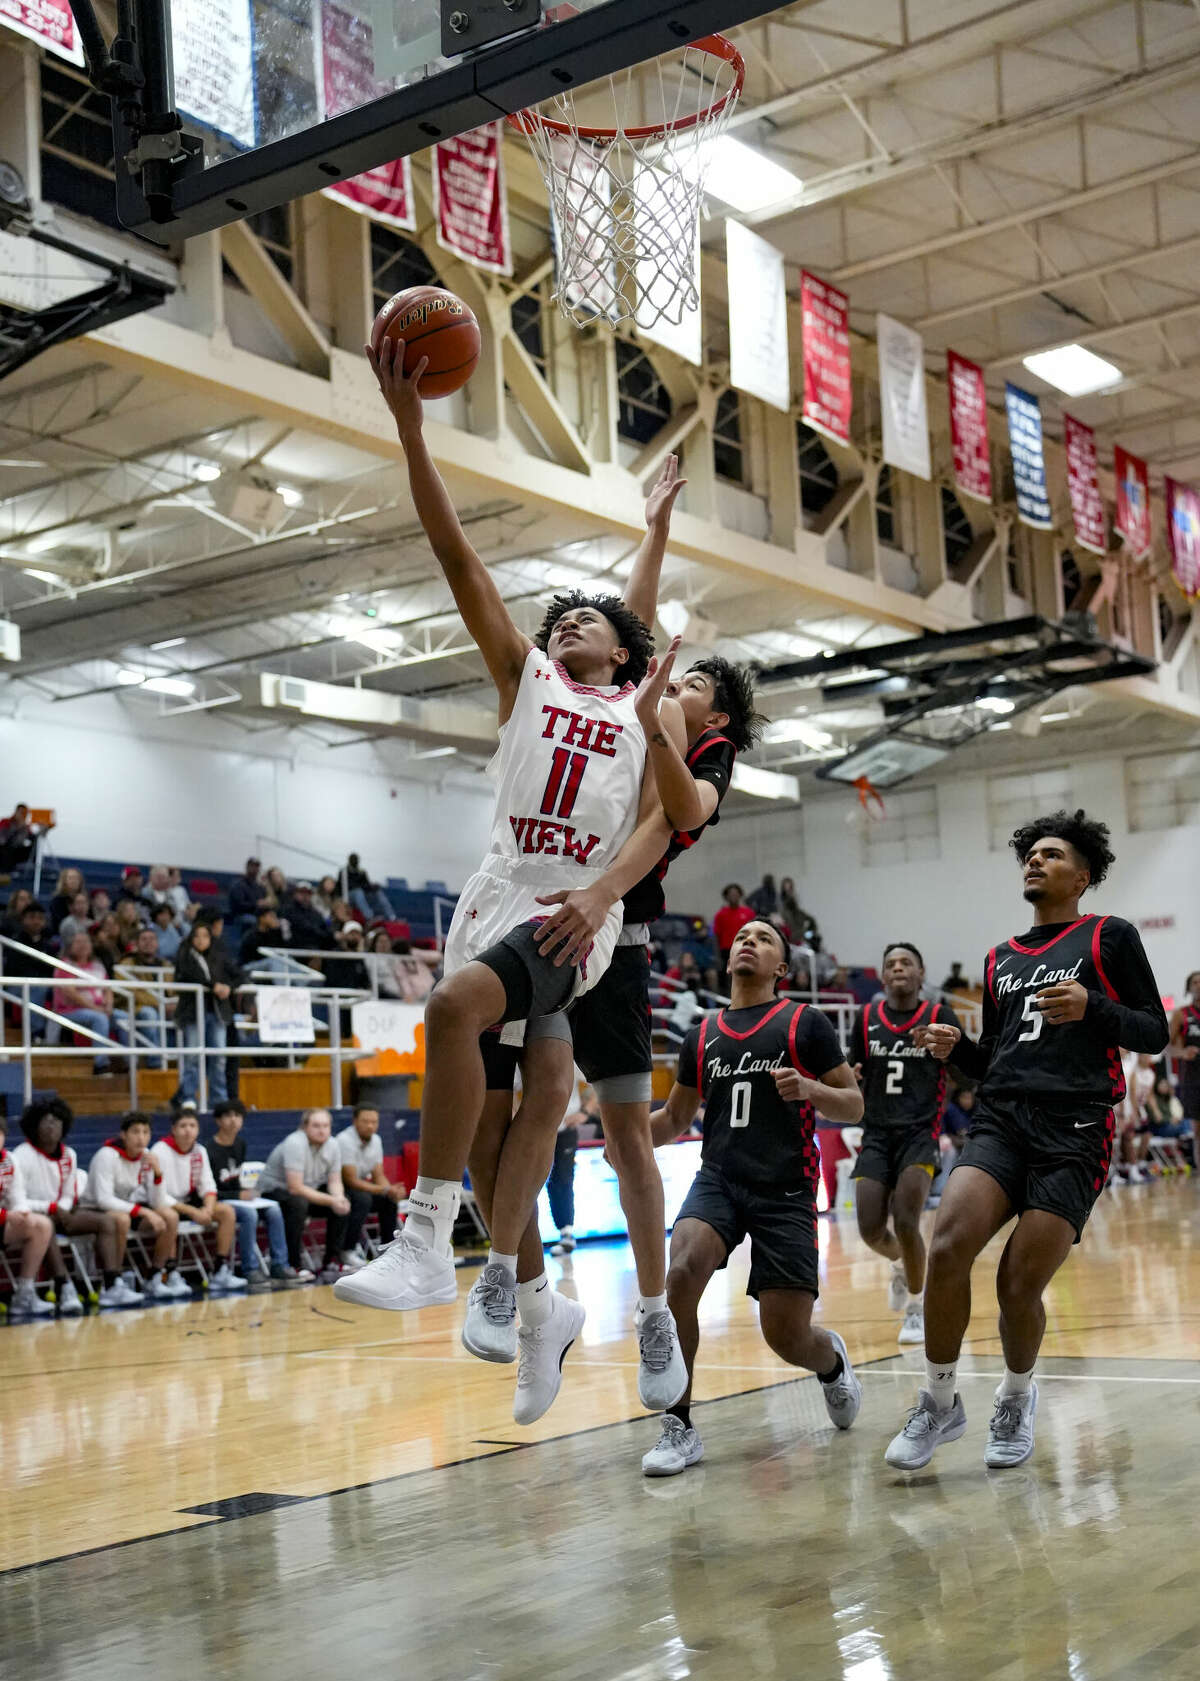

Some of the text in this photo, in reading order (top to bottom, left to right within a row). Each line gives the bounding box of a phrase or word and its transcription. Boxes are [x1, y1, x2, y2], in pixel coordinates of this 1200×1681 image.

[541, 705, 623, 758] THE
[540, 746, 589, 819] 11
[509, 816, 600, 865] VIEW
[997, 958, 1084, 1000] The Land
[1018, 993, 1045, 1042] 5
[707, 1051, 785, 1083] The Land
[869, 1040, 887, 1057] The
[885, 1060, 904, 1094] 2
[730, 1081, 752, 1128] 0
